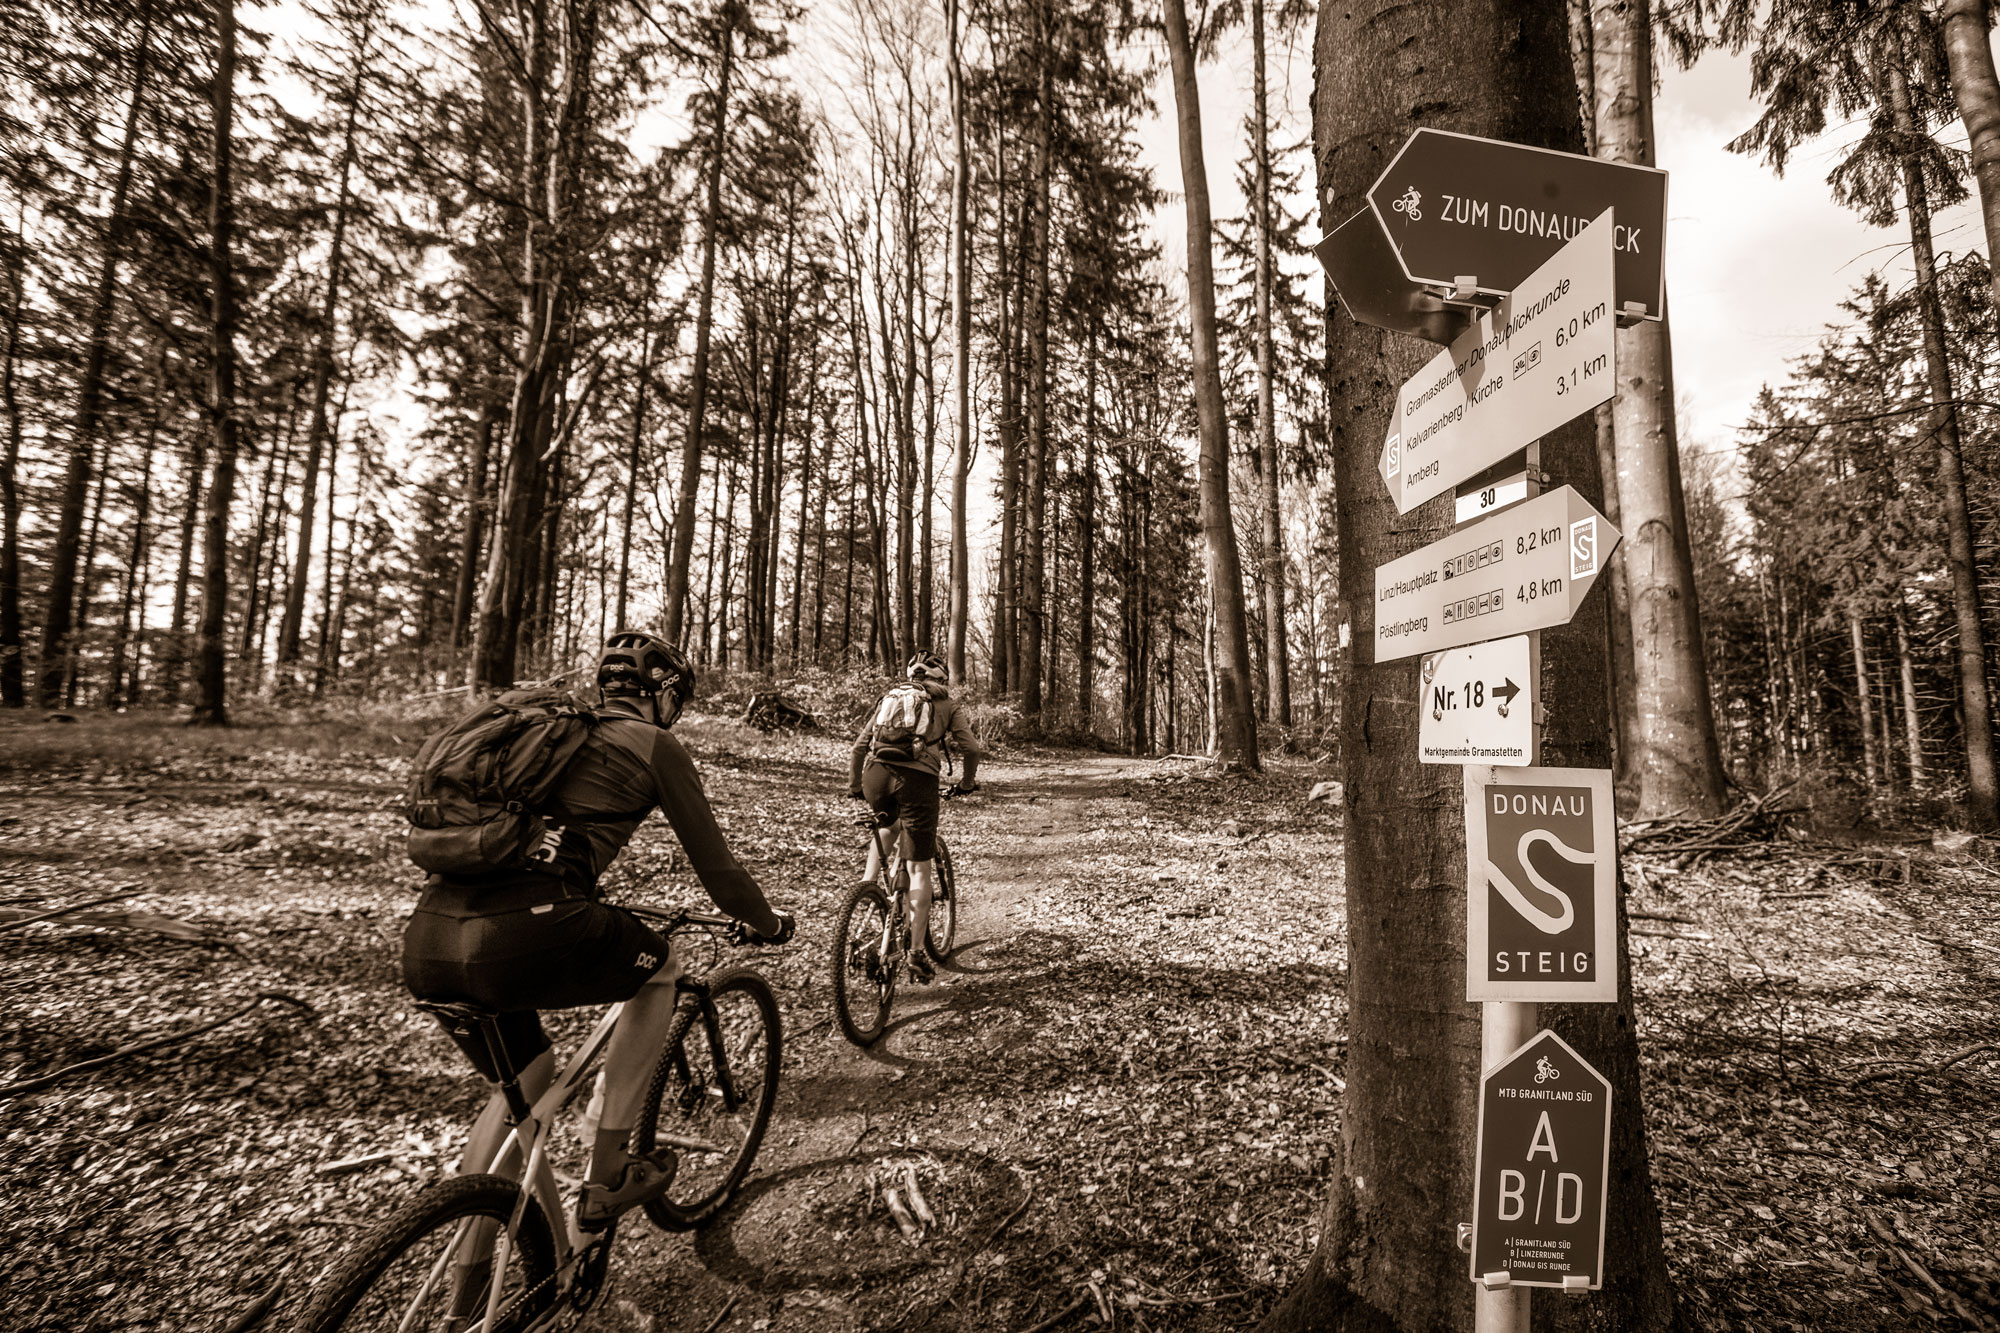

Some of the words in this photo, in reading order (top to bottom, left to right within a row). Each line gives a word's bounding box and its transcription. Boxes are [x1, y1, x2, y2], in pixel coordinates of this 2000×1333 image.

[1440, 194, 1489, 228] ZUM
[1498, 204, 1641, 254] DONAUCK
[1556, 318, 1578, 347] 6,0
[1583, 301, 1606, 326] km
[1406, 358, 1468, 417] Gramastettner
[1470, 278, 1570, 368] Donaublickrunde
[1556, 367, 1577, 396] 3,1
[1584, 353, 1607, 380] km
[1406, 404, 1463, 453] Kalvarienberg
[1471, 375, 1504, 408] Kirche
[1406, 459, 1439, 489] Amberg
[1480, 488, 1496, 508] 30
[1379, 569, 1438, 602] Linz/Hauptplatz
[1516, 532, 1537, 555] 8,2
[1541, 525, 1562, 547] km
[1379, 616, 1428, 640] Pöstlingberg
[1516, 582, 1538, 604] 4,8
[1541, 577, 1562, 597] km
[1434, 685, 1457, 711] Nr.
[1463, 680, 1484, 709] 18
[1424, 747, 1470, 758] Marktgemeinde
[1471, 746, 1523, 757] Gramastetten
[1493, 793, 1585, 817] DONAU
[1495, 951, 1588, 974] STEIG
[1498, 1088, 1517, 1098] MTB
[1519, 1089, 1574, 1101] GRANITLAND
[1576, 1090, 1593, 1102] SÜD
[1526, 1110, 1559, 1163] A
[1504, 1238, 1510, 1246] A
[1515, 1238, 1557, 1248] GRANITLAND
[1558, 1240, 1571, 1250] SÜD
[1510, 1249, 1515, 1257] B
[1520, 1250, 1565, 1260] LINZERRUNDE
[1513, 1260, 1536, 1269] DONAU
[1537, 1262, 1548, 1270] GIS
[1549, 1262, 1571, 1271] RUNDE
